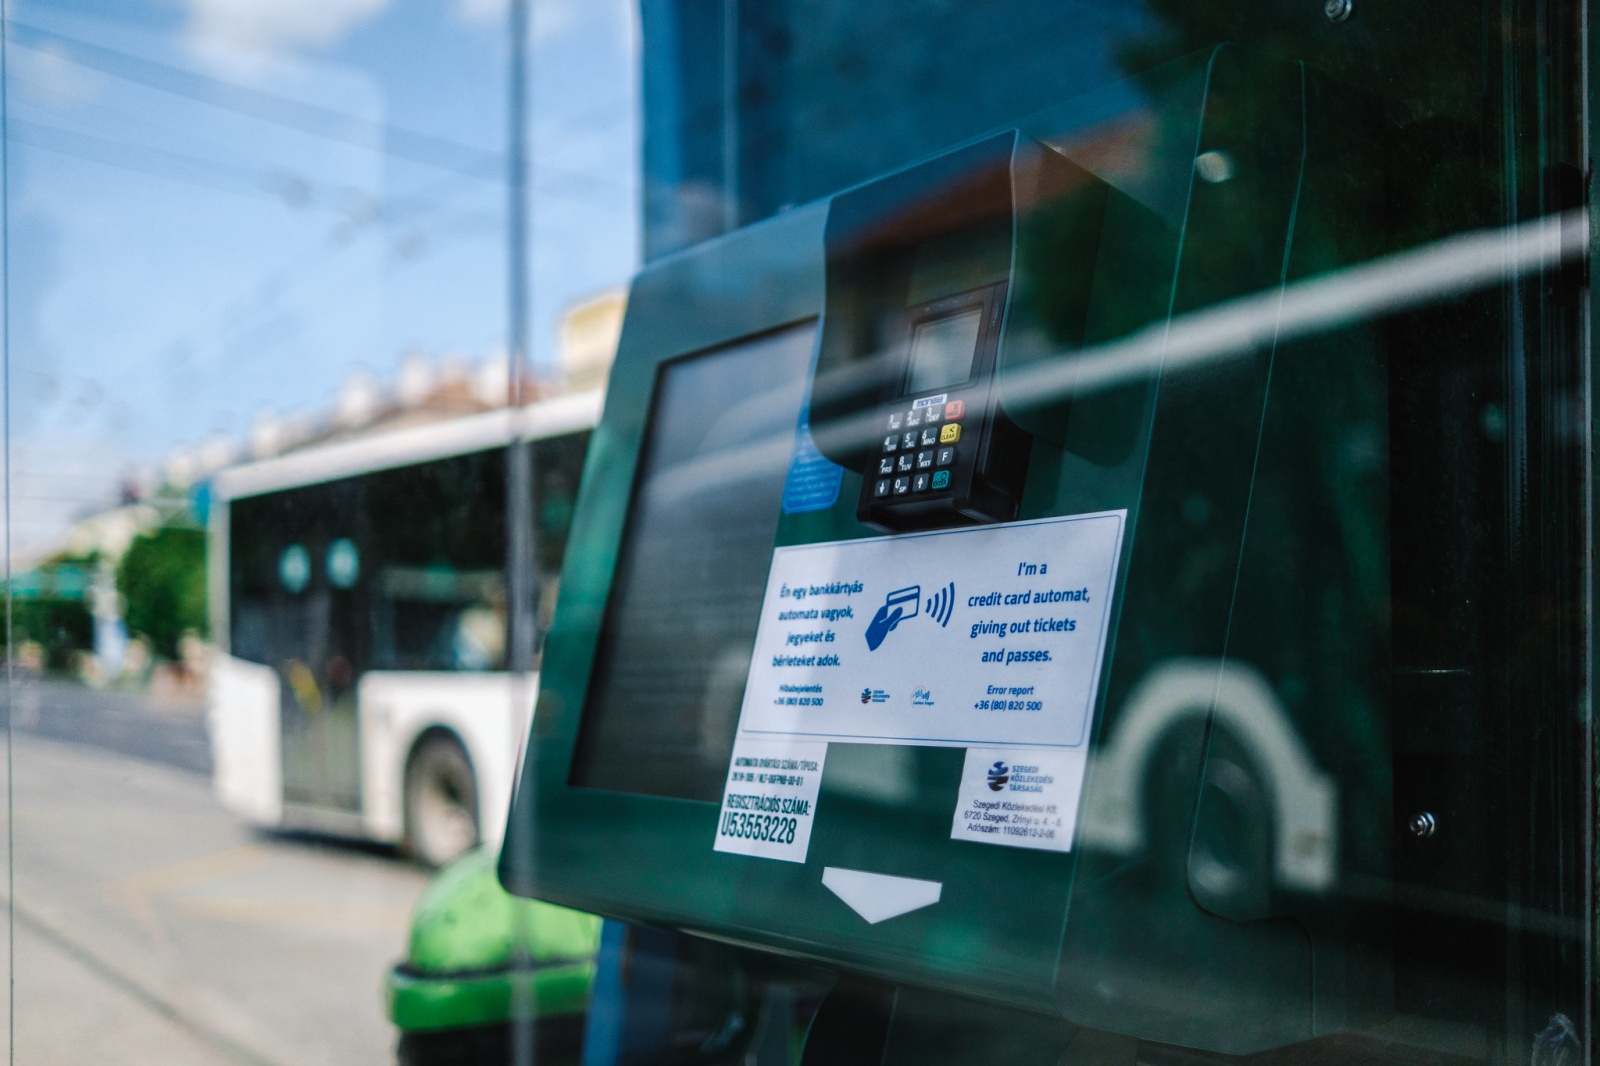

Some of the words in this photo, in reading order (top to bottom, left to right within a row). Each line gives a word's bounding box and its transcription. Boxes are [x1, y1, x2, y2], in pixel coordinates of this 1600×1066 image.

[908, 411, 913, 420] 2
[927, 407, 932, 416] 3
[890, 414, 894, 424] 1
[929, 414, 940, 422] DEF
[905, 432, 910, 442] 5
[922, 430, 927, 439] 6
[884, 436, 890, 446] 4
[899, 456, 904, 465] 8
[919, 453, 924, 462] 9
[942, 452, 948, 462] F
[881, 460, 886, 468] 7
[895, 480, 900, 489] 0
[1018, 562, 1036, 576] I'm
[1040, 564, 1047, 574] a
[780, 584, 790, 598] Én
[792, 587, 806, 600] egy
[809, 580, 864, 596] bankkártyás
[968, 592, 1002, 607] credit
[1004, 590, 1031, 605] card
[1033, 588, 1090, 604] automat,
[778, 608, 818, 620] automata
[821, 606, 854, 622] vagyok,
[970, 620, 1008, 638] giving
[1010, 620, 1031, 634] out
[1034, 617, 1076, 632] tickets
[786, 631, 824, 646] jegyeket
[825, 630, 836, 642] és
[772, 654, 815, 667] bérleteket
[816, 654, 840, 666] adok.
[982, 648, 1004, 662] and
[1006, 650, 1052, 666] passes.
[987, 685, 1007, 694] Error
[1008, 686, 1034, 697] report
[786, 697, 797, 706] (80)
[798, 698, 810, 706] 820
[812, 698, 824, 706] 500
[974, 700, 990, 710] +36
[990, 700, 1007, 711] (80)
[1008, 701, 1024, 710] 820
[1026, 701, 1042, 710] 500
[1012, 765, 1039, 773] SZEGEDI
[1009, 784, 1042, 792] TÁRSASÁG
[726, 794, 781, 813] REGISZTRÁCIÓS
[782, 796, 811, 816] SZÁMA:
[973, 800, 1000, 811] Szegedi
[1002, 802, 1044, 813] Közlekedési
[964, 810, 981, 819] 6720
[983, 812, 1010, 824] Szeged,
[722, 811, 797, 844] U53553228
[967, 822, 1000, 834] Adószám:
[1004, 826, 1056, 838] 11092612-2-06
